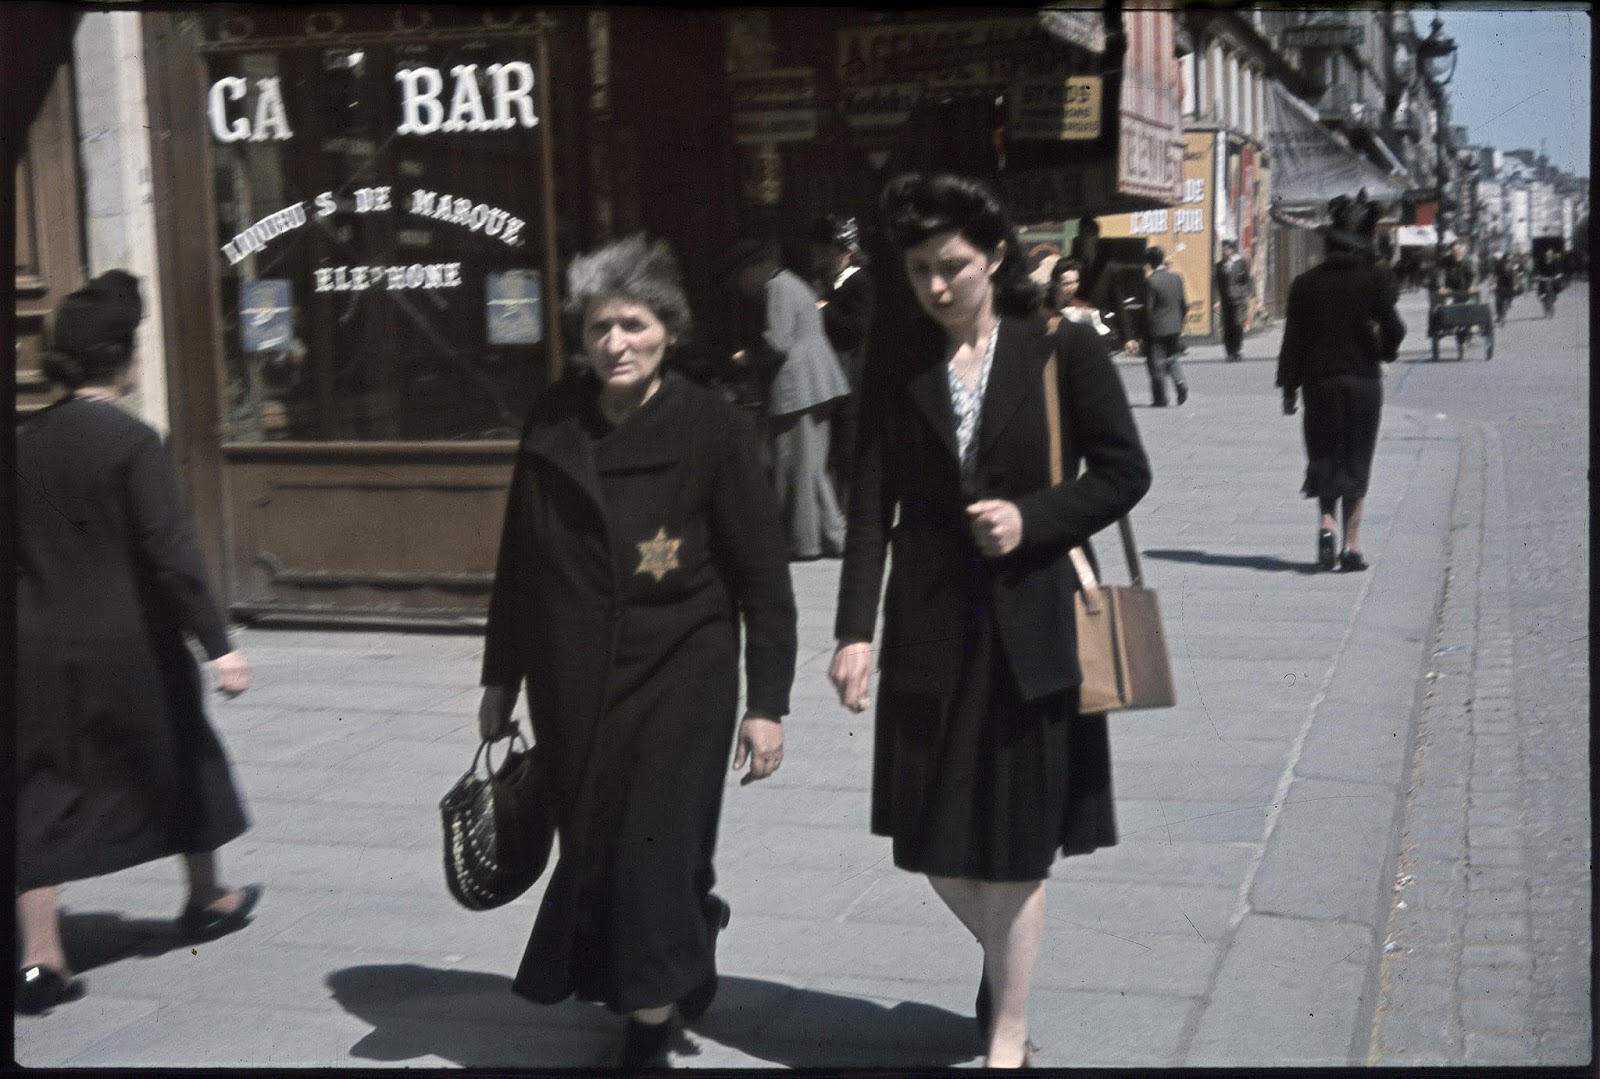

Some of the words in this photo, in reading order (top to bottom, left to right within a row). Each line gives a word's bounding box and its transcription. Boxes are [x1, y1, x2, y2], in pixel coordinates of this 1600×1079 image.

[394, 61, 540, 136] BAR
[220, 191, 337, 266] LIQUEUS
[352, 186, 392, 213] DE
[409, 188, 526, 248] MARQUE
[1173, 208, 1204, 233] PUR
